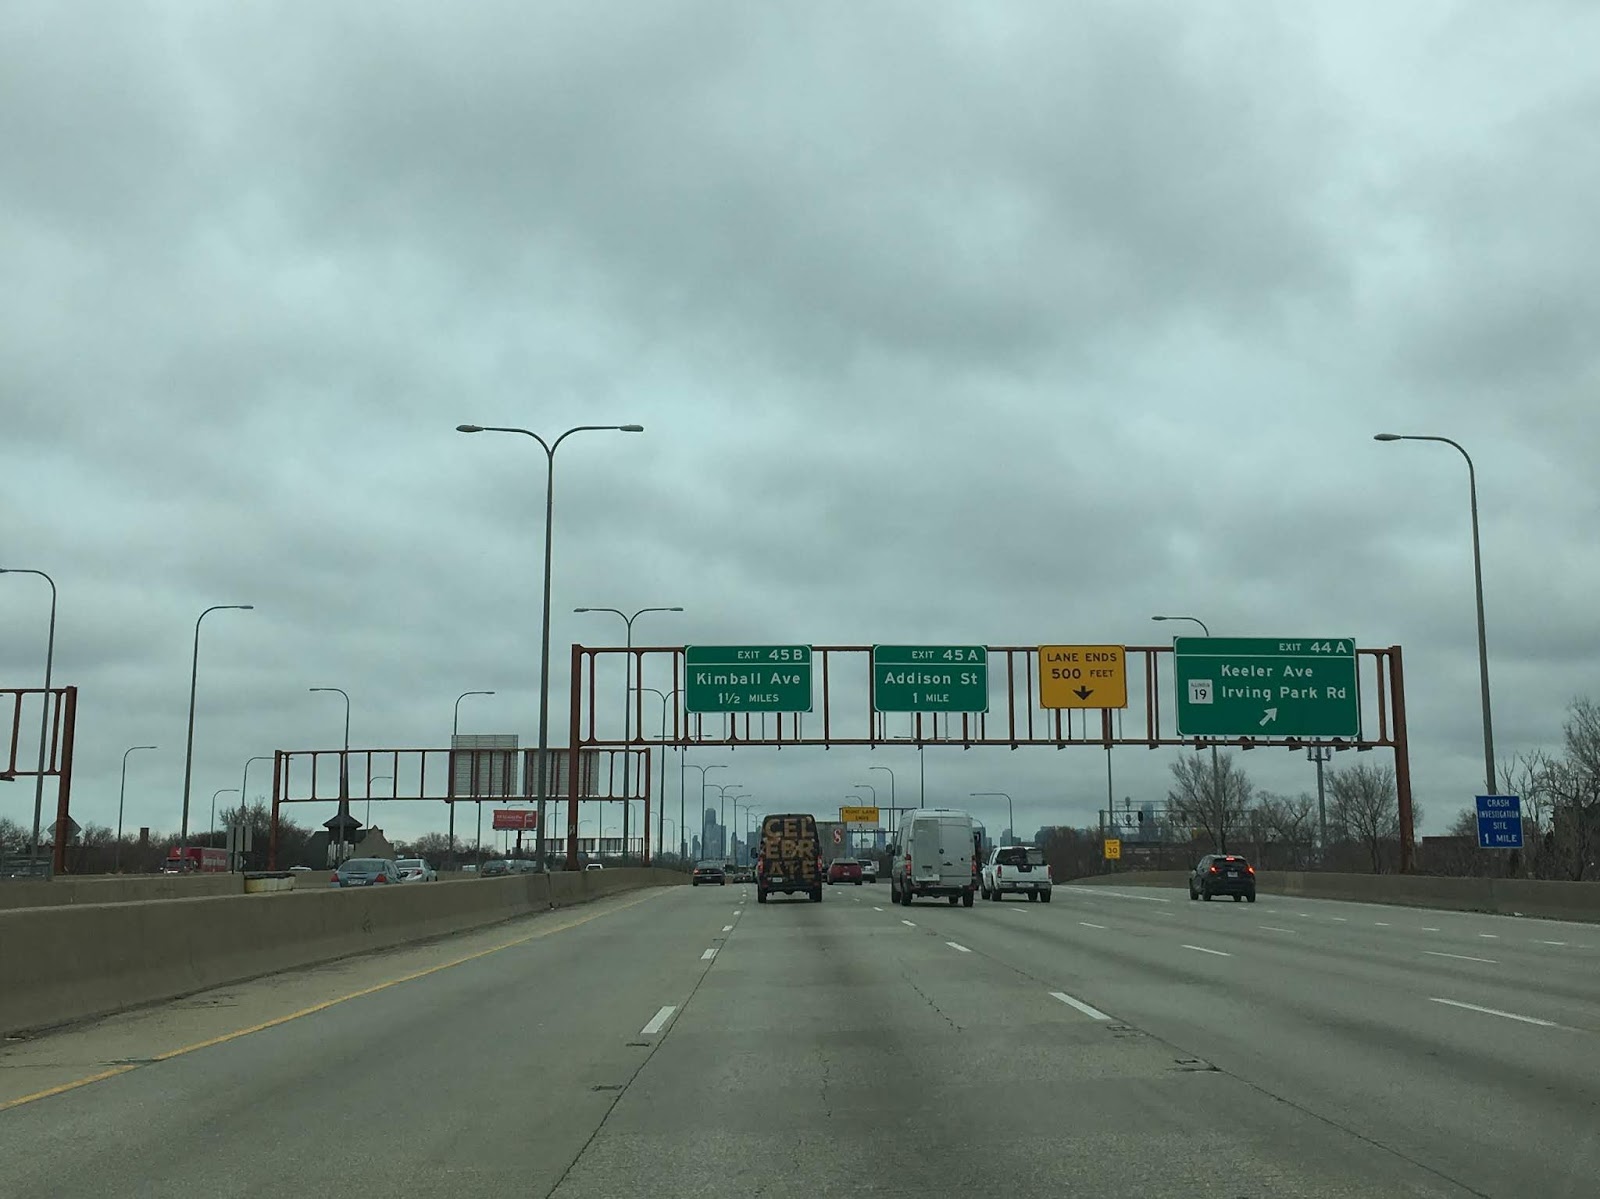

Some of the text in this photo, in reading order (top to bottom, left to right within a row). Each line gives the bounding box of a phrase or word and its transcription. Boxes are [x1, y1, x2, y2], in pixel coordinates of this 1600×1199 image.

[1279, 643, 1301, 651] EXIT
[737, 651, 760, 659] EXIT
[911, 651, 934, 659] EXIT
[1047, 653, 1117, 662] LANE ENDS
[1052, 668, 1114, 679] 500 FEET
[1221, 664, 1313, 677] Keeler Ave
[696, 672, 801, 685] Kimball Ave
[884, 672, 978, 685] Addison St
[749, 694, 780, 703] MILES
[913, 692, 950, 704] 1 MILE
[1194, 689, 1207, 700] 19
[1222, 686, 1347, 702] Irving Park Rd
[1487, 799, 1510, 807] CRASH
[1479, 810, 1519, 818] INVESTIGATION
[765, 818, 815, 838] CEL
[1493, 821, 1507, 829] SITE
[1484, 833, 1517, 844] 1 MILE
